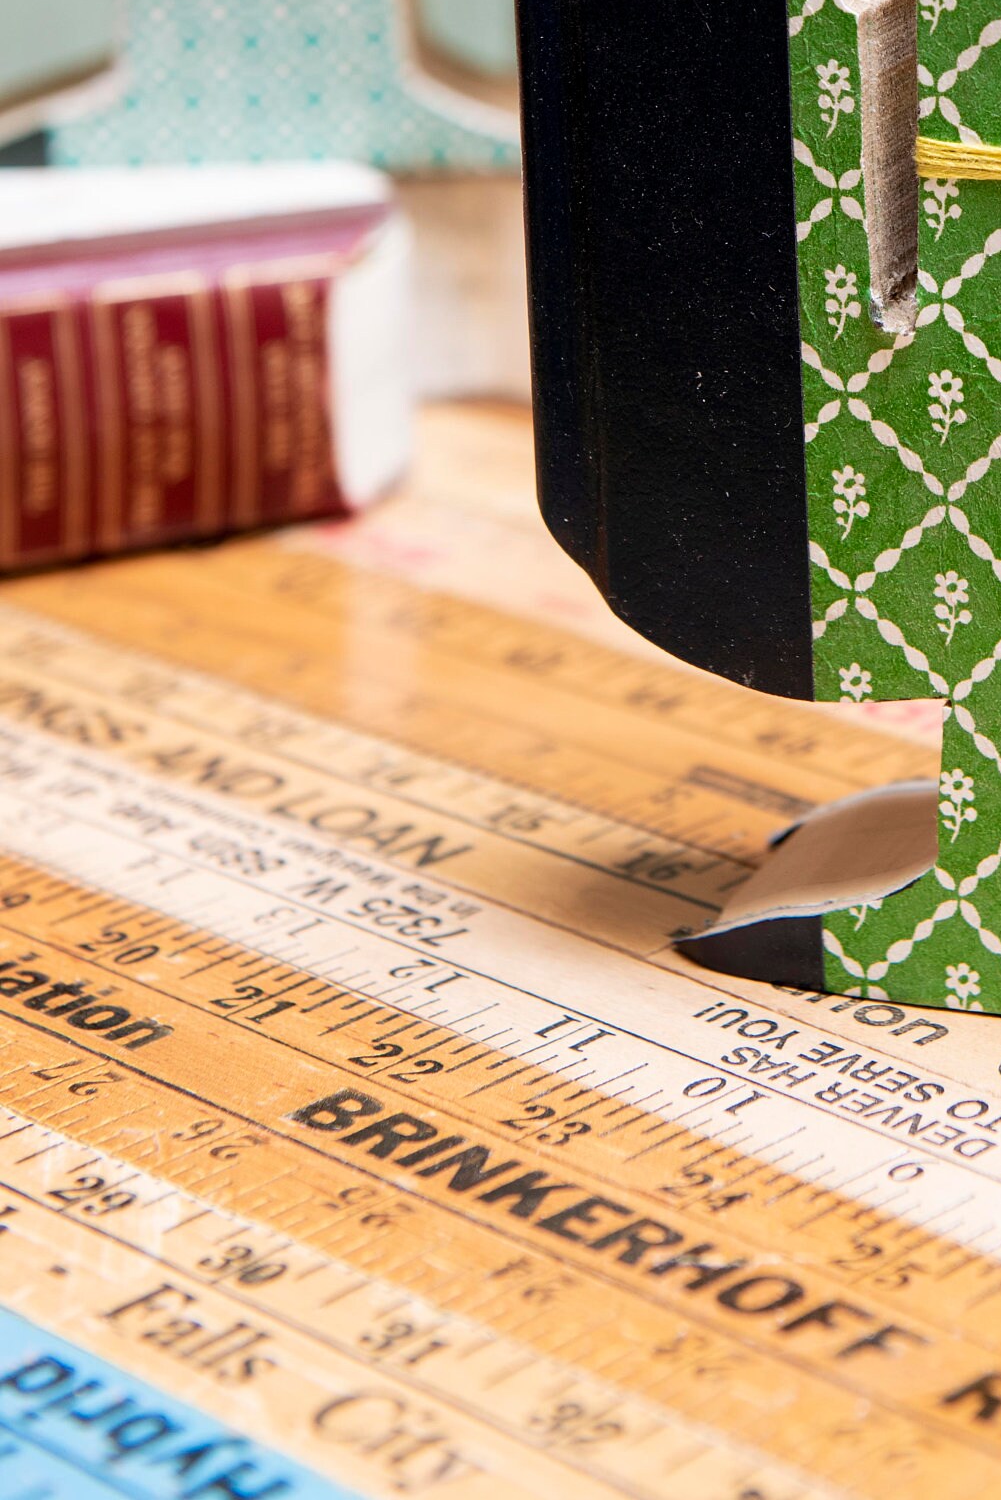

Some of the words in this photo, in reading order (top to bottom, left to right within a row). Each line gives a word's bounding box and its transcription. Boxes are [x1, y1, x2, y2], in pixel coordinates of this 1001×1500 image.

[268, 788, 476, 868] LOAN
[254, 905, 336, 938] 13
[347, 896, 470, 947] 7325
[77, 930, 161, 966] 20
[388, 958, 472, 993] 12
[209, 985, 297, 1025] 21
[691, 1001, 801, 1051] YOU!
[534, 1014, 617, 1053] 11
[31, 1059, 128, 1097] 27
[347, 1042, 444, 1084] 22
[720, 1045, 818, 1089] HAS
[797, 1040, 945, 1103] SERVE
[682, 1076, 772, 1116] 10
[172, 1118, 270, 1160] 26
[500, 1103, 592, 1146] 23
[814, 1080, 998, 1159] DENVER
[46, 1174, 137, 1216] 29
[657, 1170, 753, 1214] 24
[284, 1086, 930, 1360] BRINKERHOFF
[197, 1245, 288, 1285] 30
[830, 1241, 930, 1292] 25
[359, 1322, 451, 1366] 31
[102, 1283, 278, 1382] Falls
[311, 1388, 488, 1492] City
